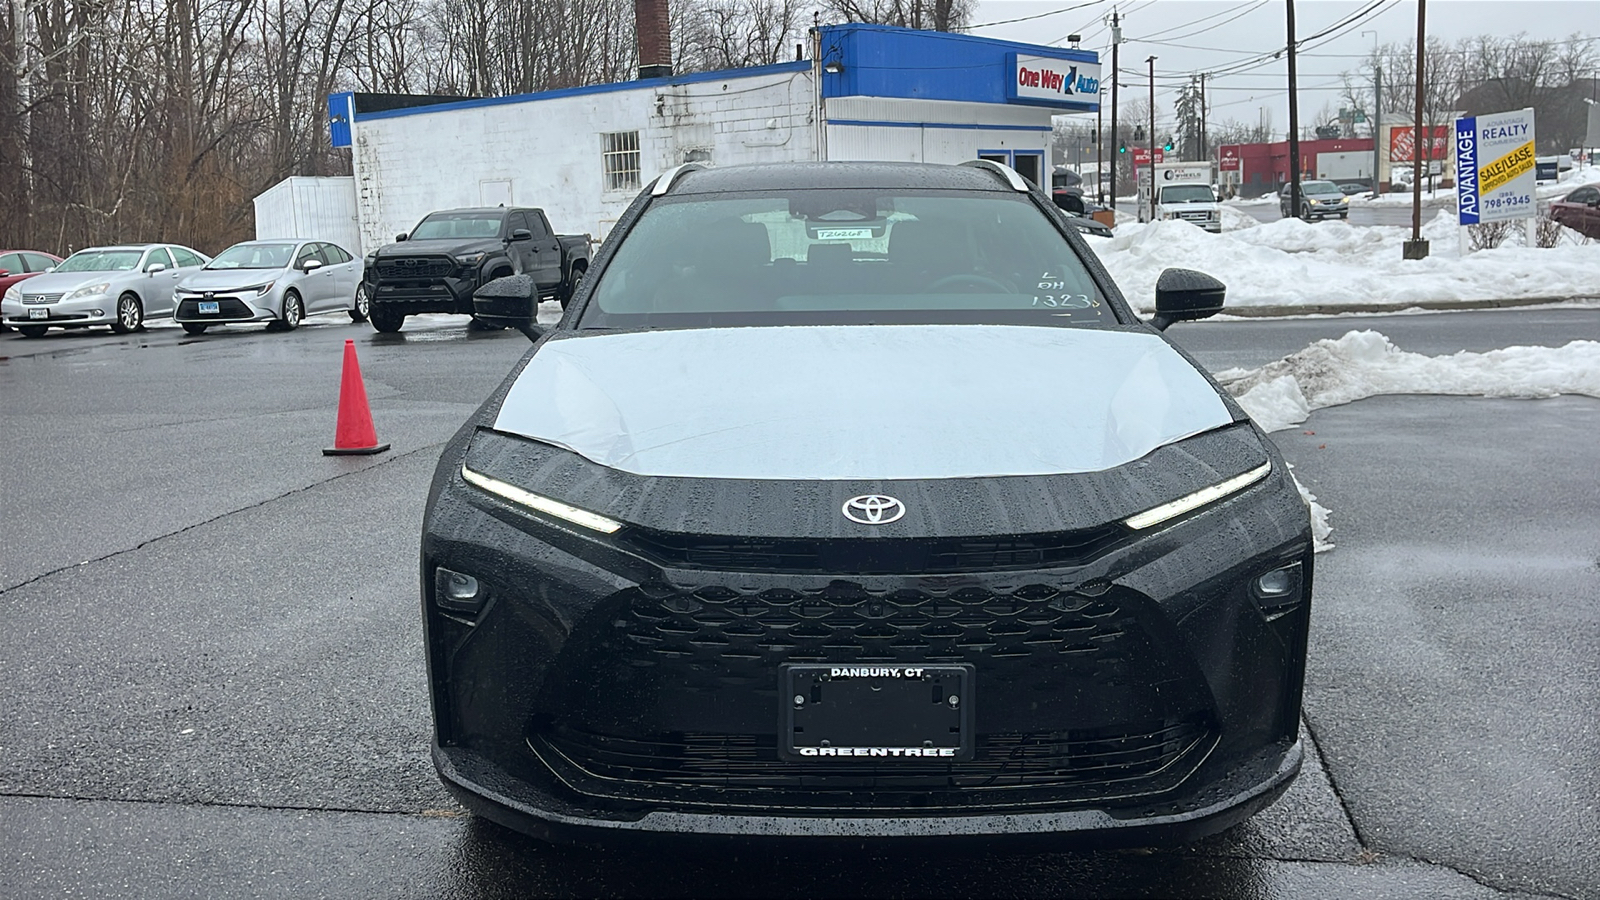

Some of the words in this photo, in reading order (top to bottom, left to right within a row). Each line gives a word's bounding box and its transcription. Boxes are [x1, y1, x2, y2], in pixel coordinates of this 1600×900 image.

[1019, 66, 1040, 88] One
[1041, 69, 1064, 93] Way
[1075, 74, 1099, 94] Auto
[1486, 117, 1524, 127] ADVANTAGE
[1482, 123, 1528, 140] REALTY
[1483, 136, 1528, 147] COMMERCIAL
[1458, 130, 1479, 216] ADVANTAGE
[1480, 147, 1533, 182] SALE/LEASE
[1482, 174, 1506, 191] APPROVED
[1506, 167, 1520, 178] AUTO
[1518, 160, 1533, 172] SALES
[831, 668, 901, 678] DANBURY,
[904, 668, 924, 677] CT
[800, 748, 955, 757] GREENTREE
